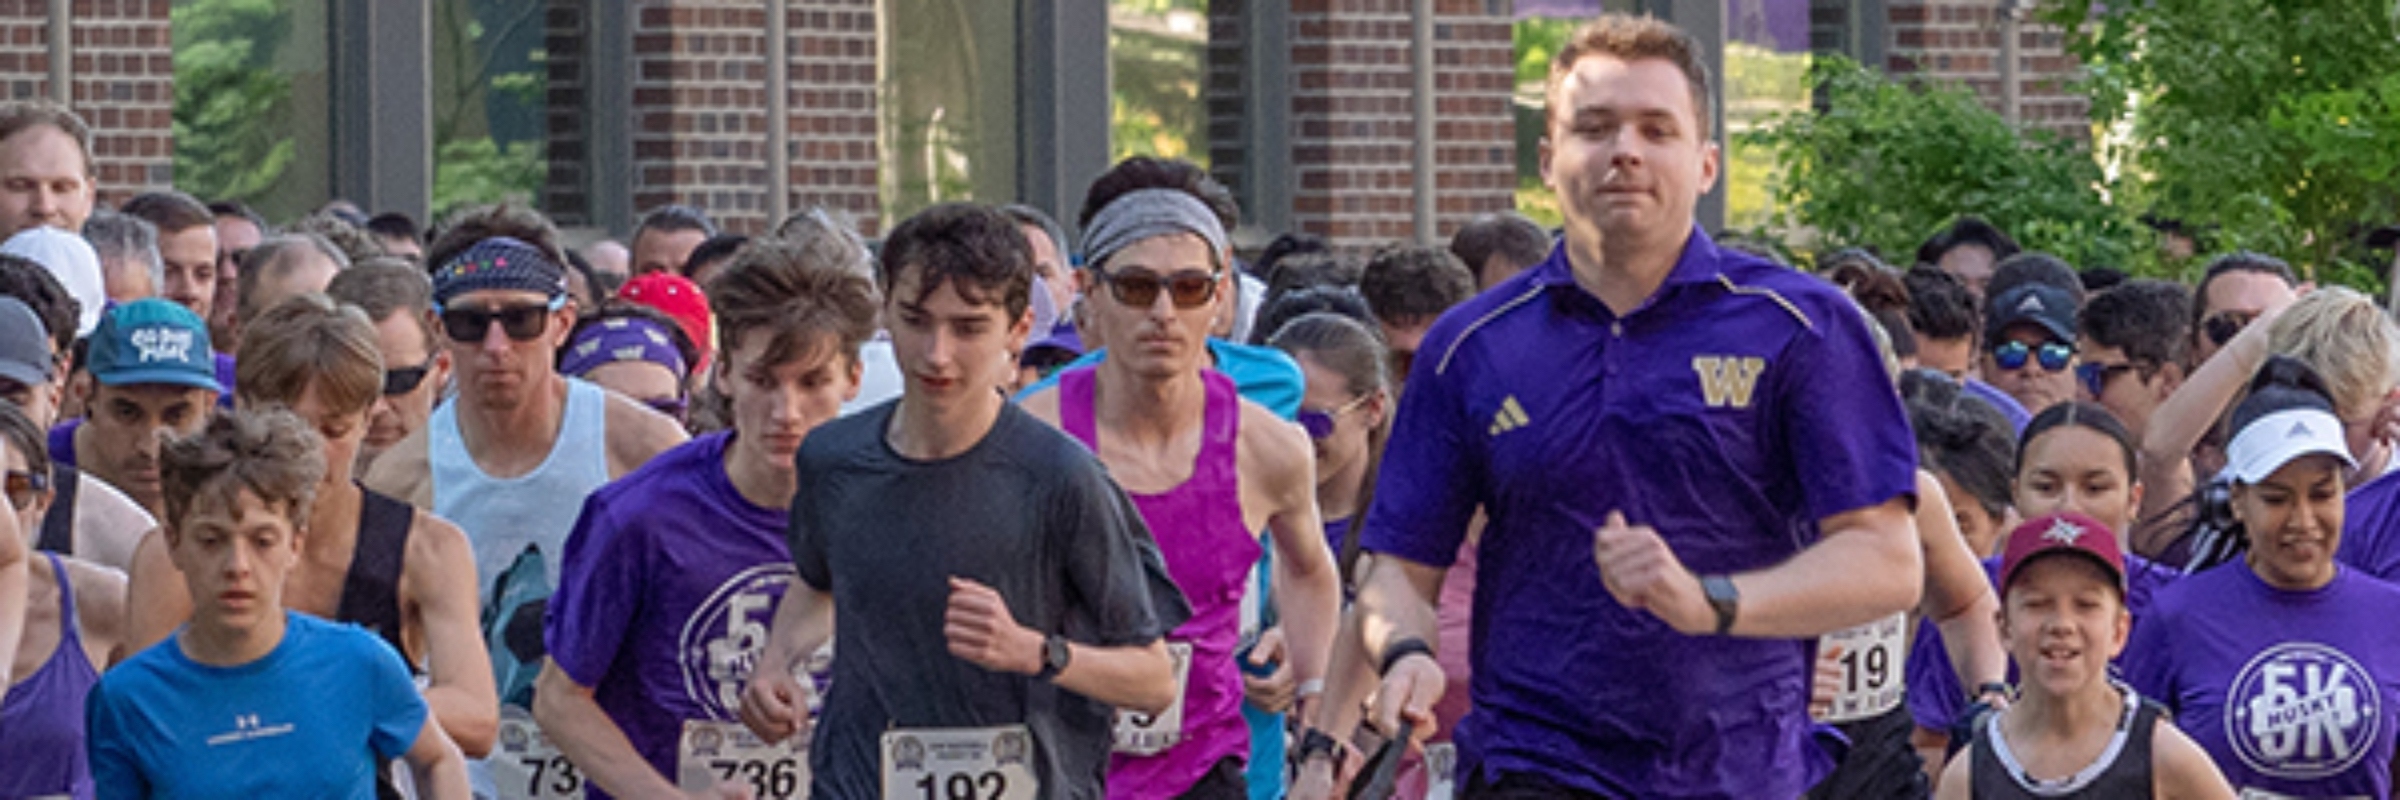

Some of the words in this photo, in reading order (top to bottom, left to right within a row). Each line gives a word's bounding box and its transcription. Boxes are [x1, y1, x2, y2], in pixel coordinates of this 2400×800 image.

[1691, 356, 1765, 407] W
[1839, 643, 1889, 693] 19
[2259, 662, 2350, 760] 5K
[711, 758, 797, 799] 736
[914, 770, 1006, 800] 192
